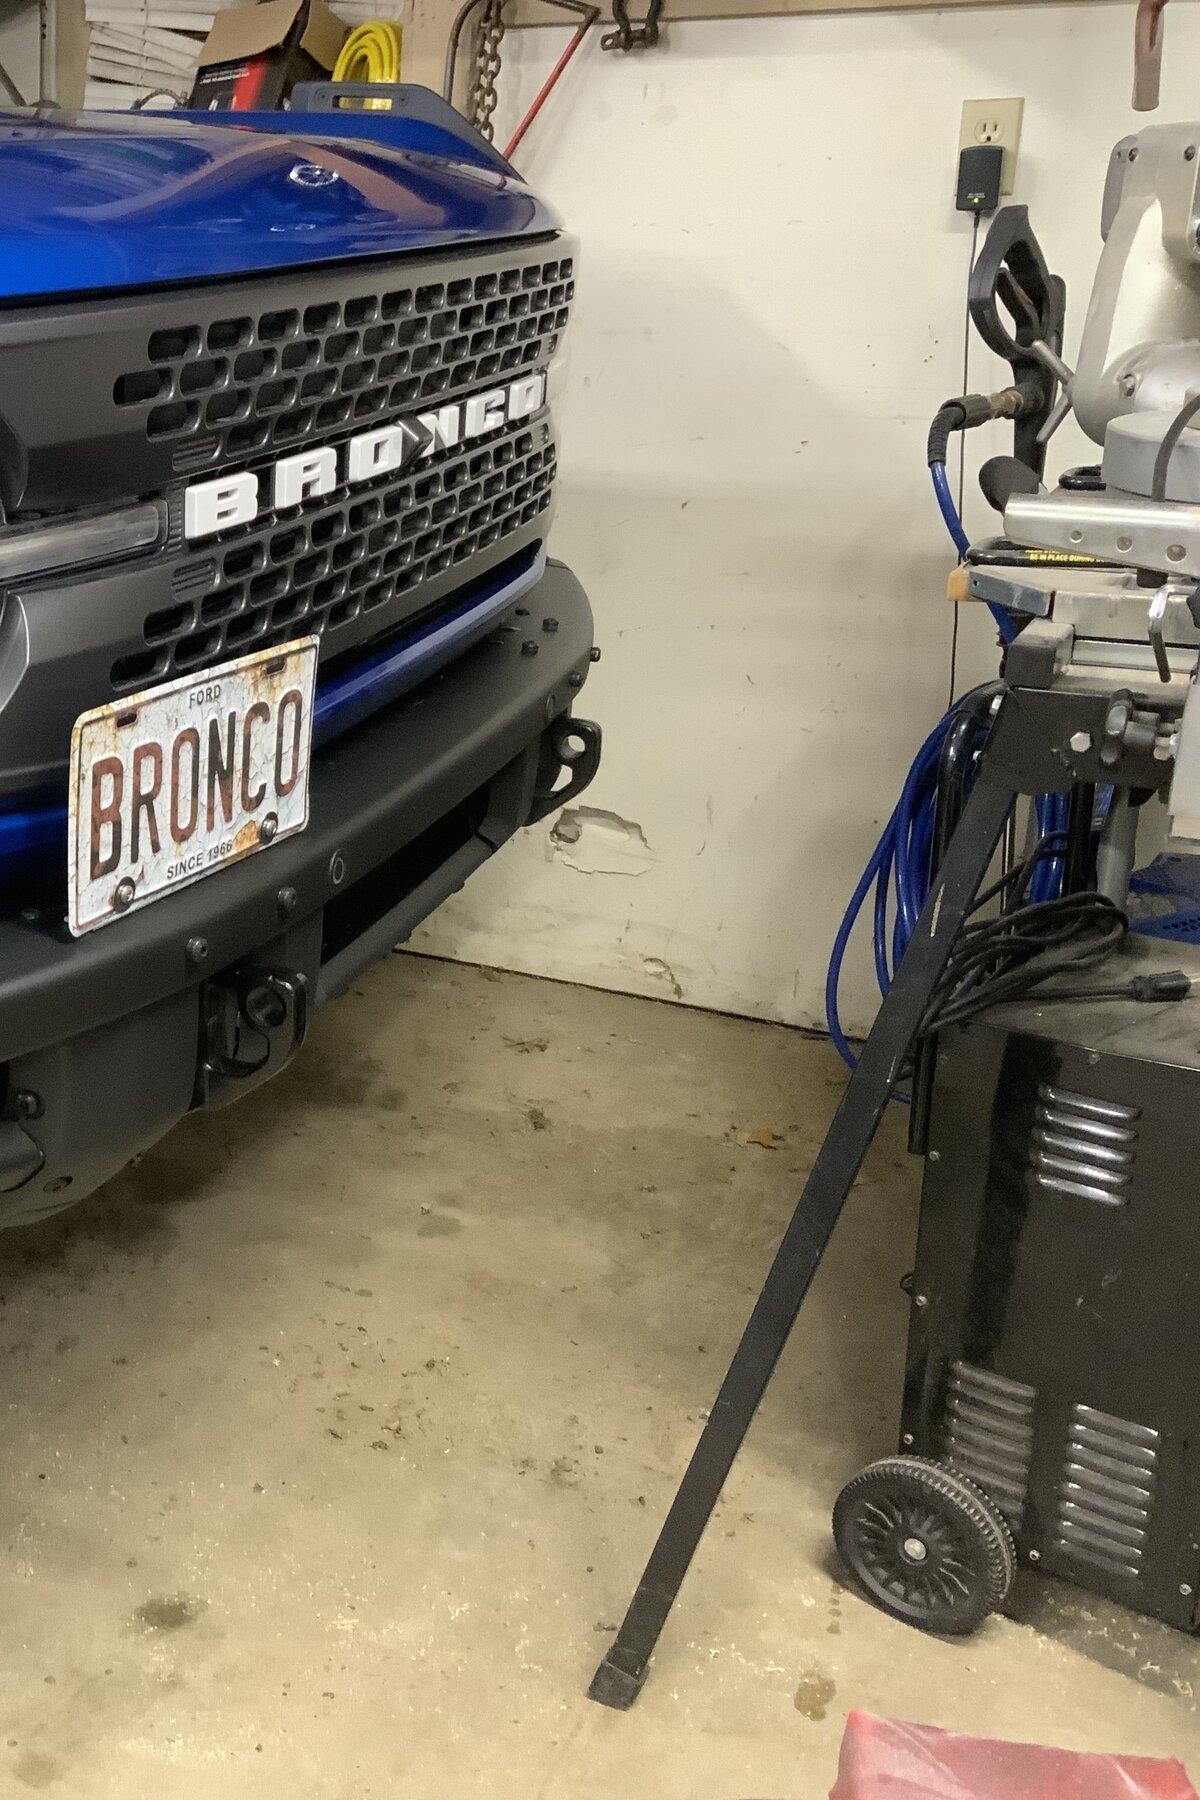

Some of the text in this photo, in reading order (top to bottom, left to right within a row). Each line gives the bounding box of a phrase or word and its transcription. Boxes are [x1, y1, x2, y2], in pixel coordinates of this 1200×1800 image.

[185, 374, 542, 540] BRONCO
[1047, 554, 1069, 562] PLACE
[189, 684, 222, 709] FORD
[90, 689, 303, 881] BRONCO
[167, 839, 233, 879] SINCE 1966
